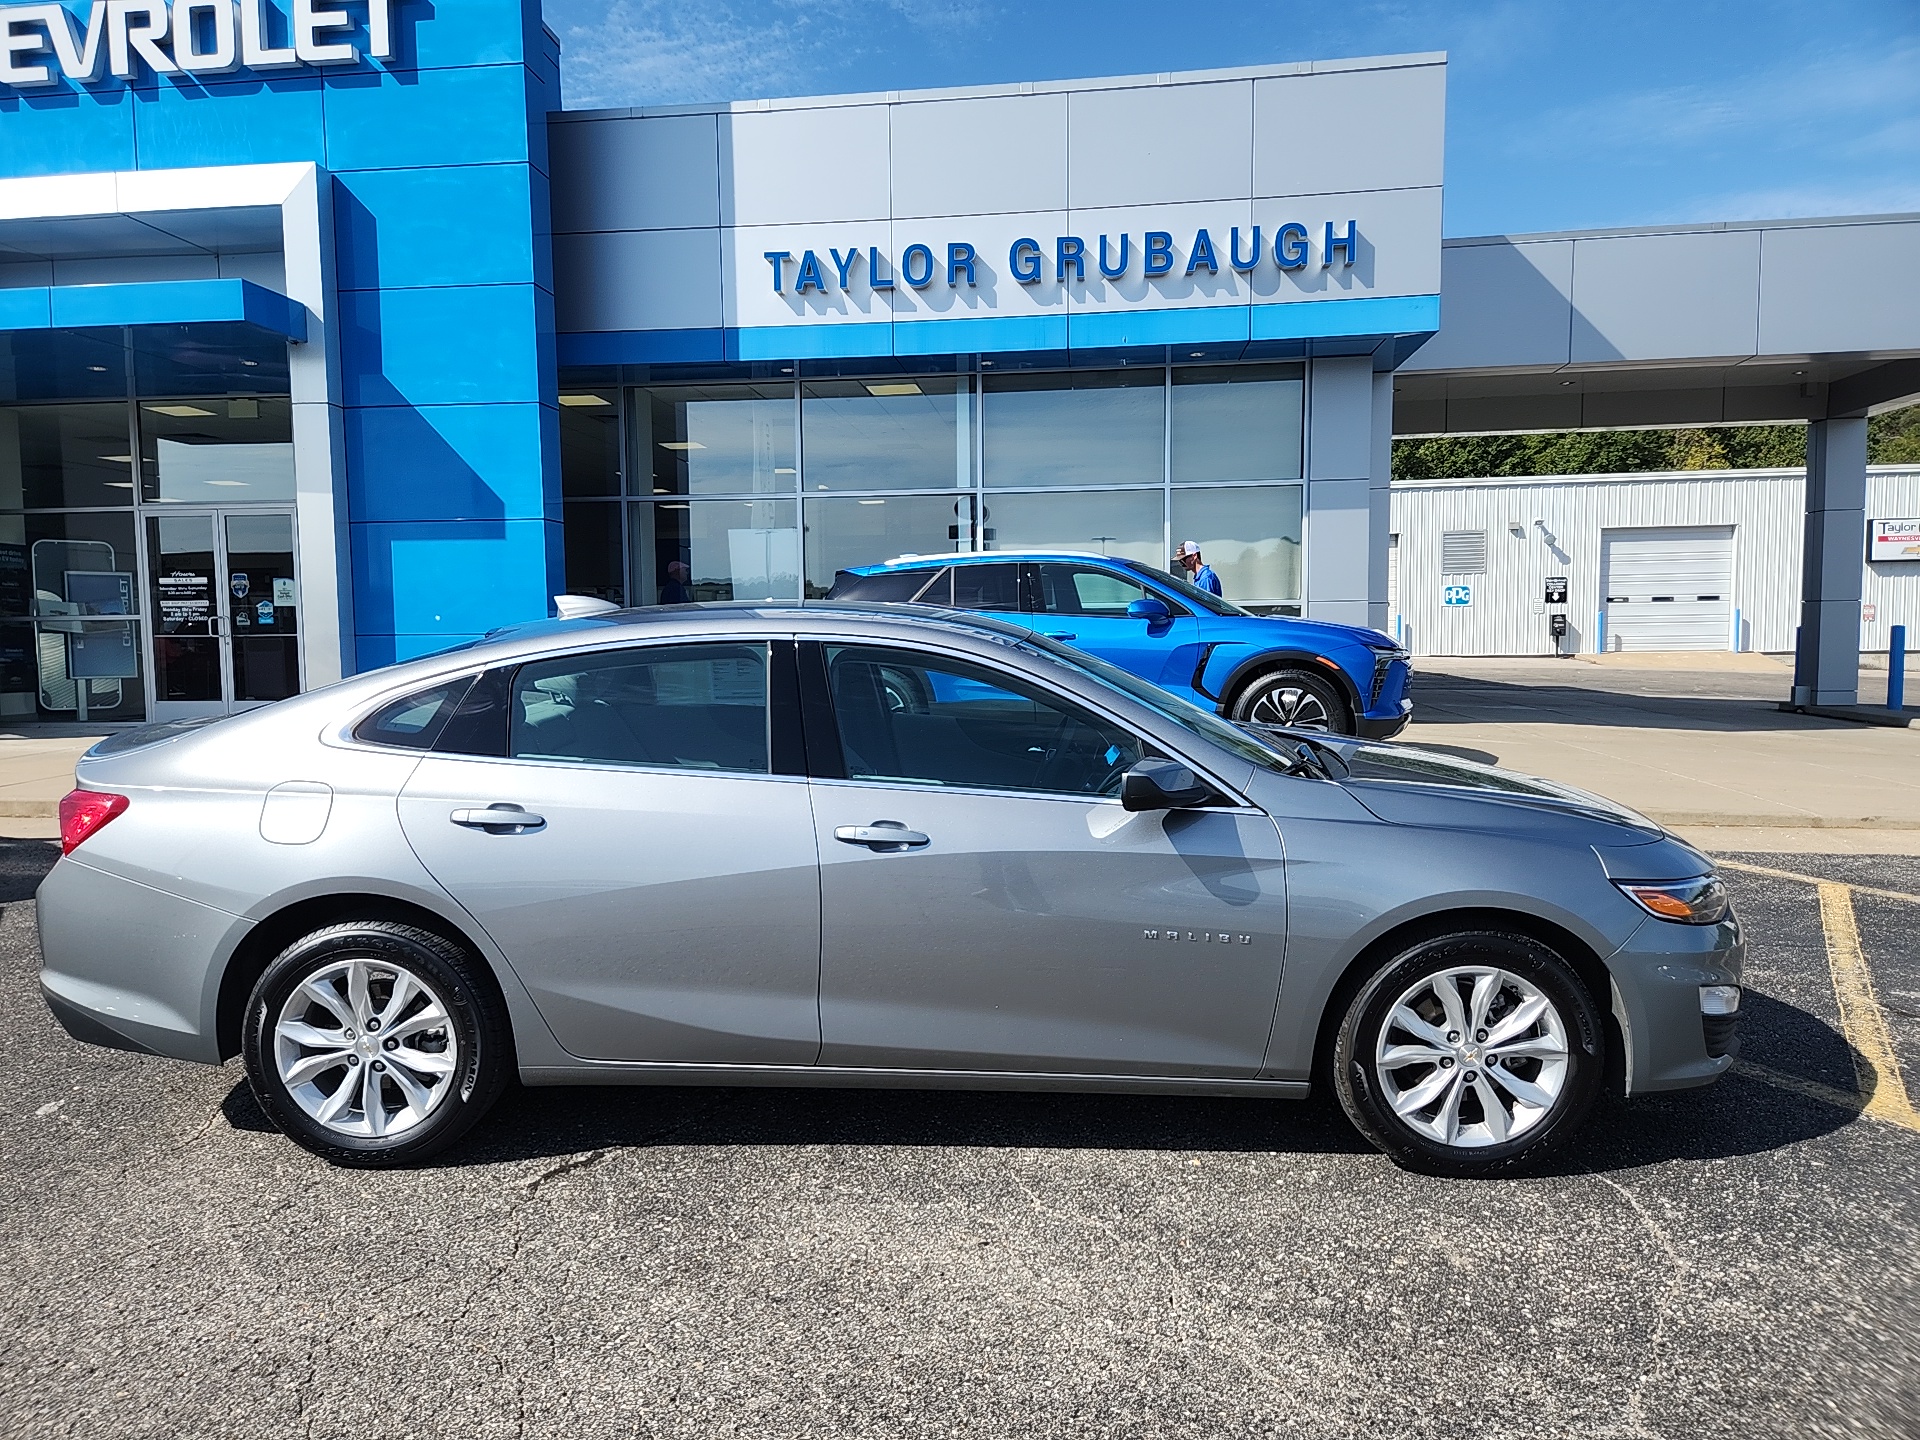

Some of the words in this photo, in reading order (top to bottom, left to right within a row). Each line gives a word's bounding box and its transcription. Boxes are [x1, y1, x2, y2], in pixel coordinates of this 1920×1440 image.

[764, 241, 978, 294] TAYLOR
[1009, 219, 1358, 285] GRUBAUGH
[1878, 521, 1917, 534] Taylor
[1446, 588, 1469, 603] PPG
[1143, 929, 1251, 945] MALIBU
